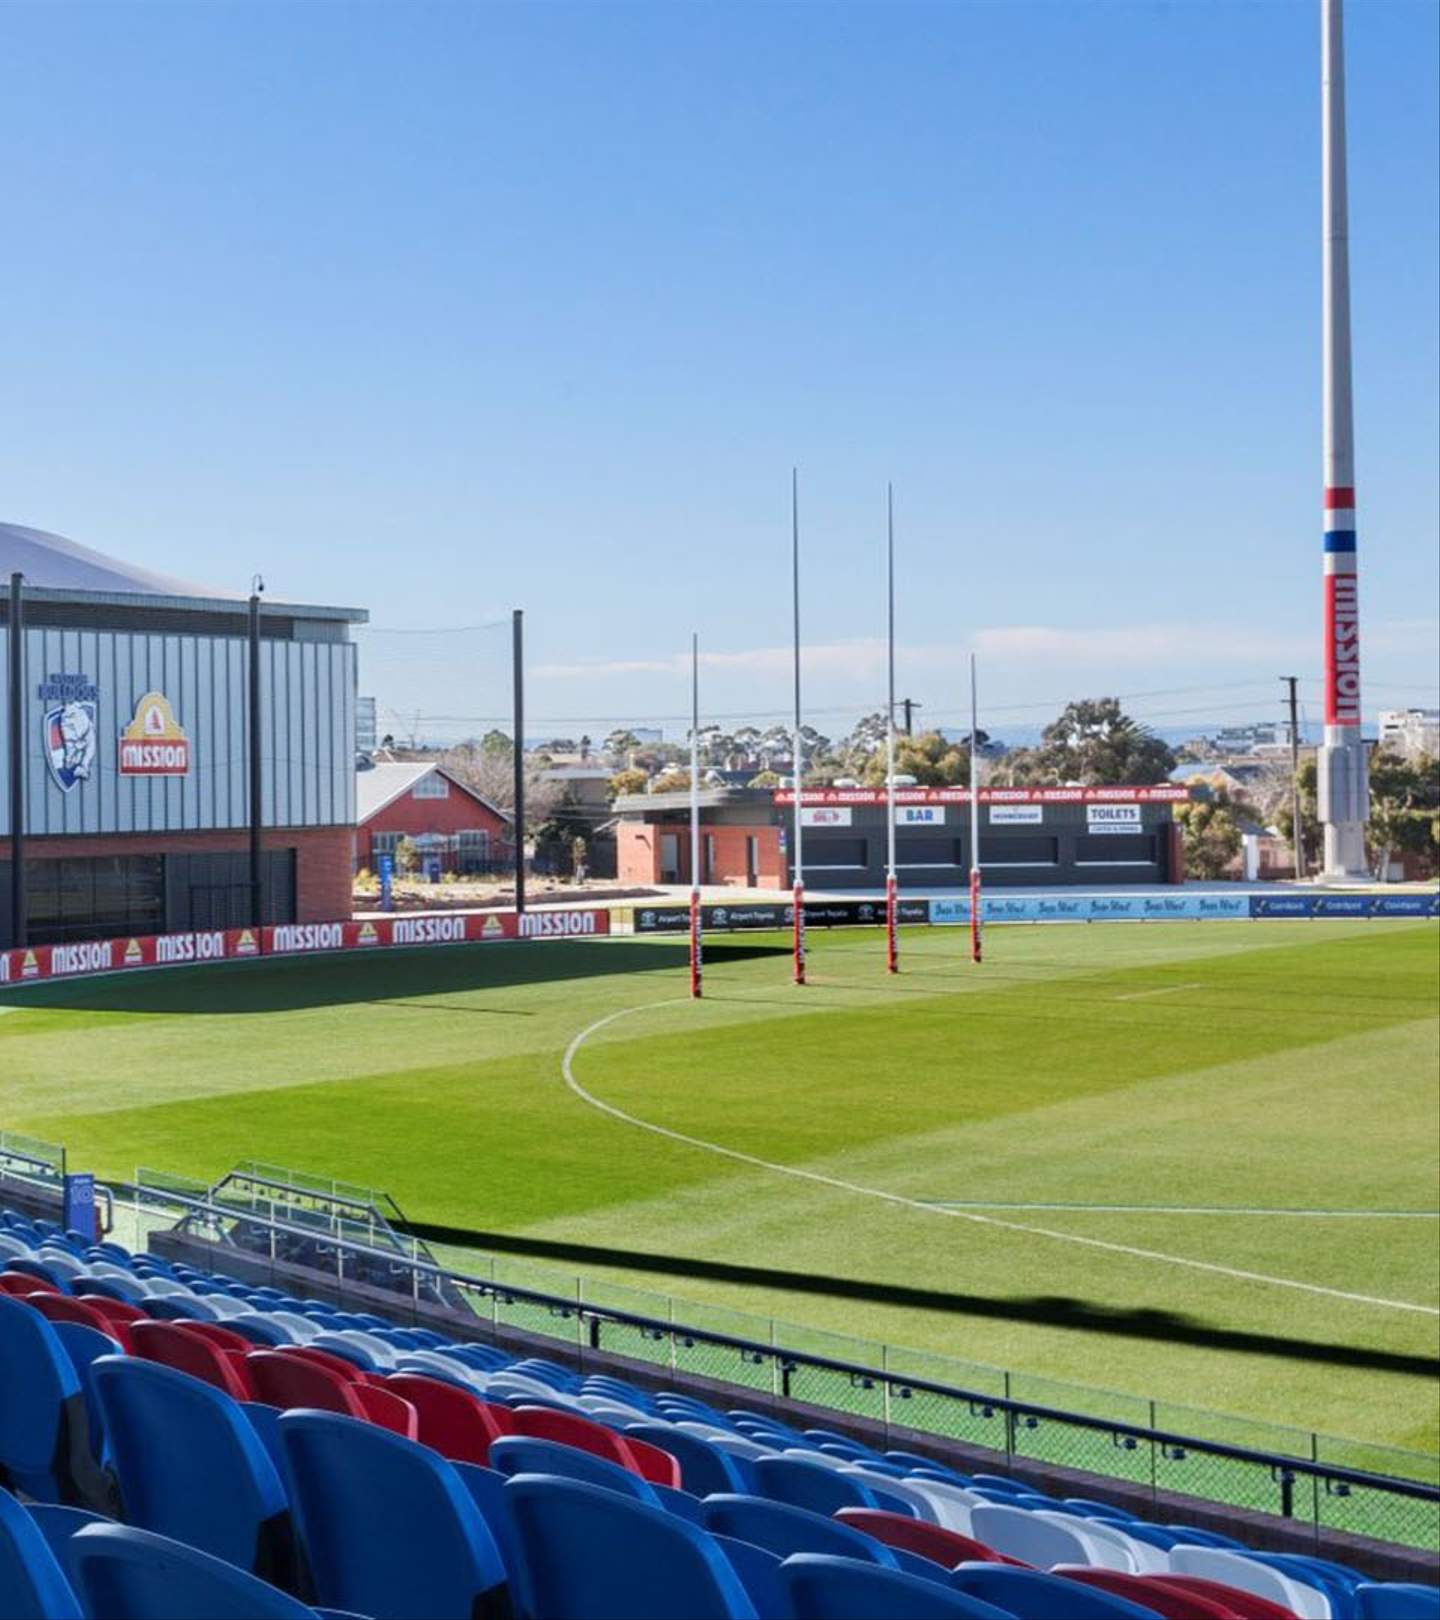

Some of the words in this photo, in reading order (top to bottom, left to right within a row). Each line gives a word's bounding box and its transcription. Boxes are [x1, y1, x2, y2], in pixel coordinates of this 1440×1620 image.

[123, 745, 186, 767] MISSION
[906, 809, 933, 821] BAR
[1091, 808, 1136, 819] TOILETS
[393, 917, 465, 942] MISSION
[518, 912, 594, 936] MISSION
[156, 932, 225, 962] MISSION
[274, 924, 342, 949] MISSION
[52, 943, 112, 973] MISSION
